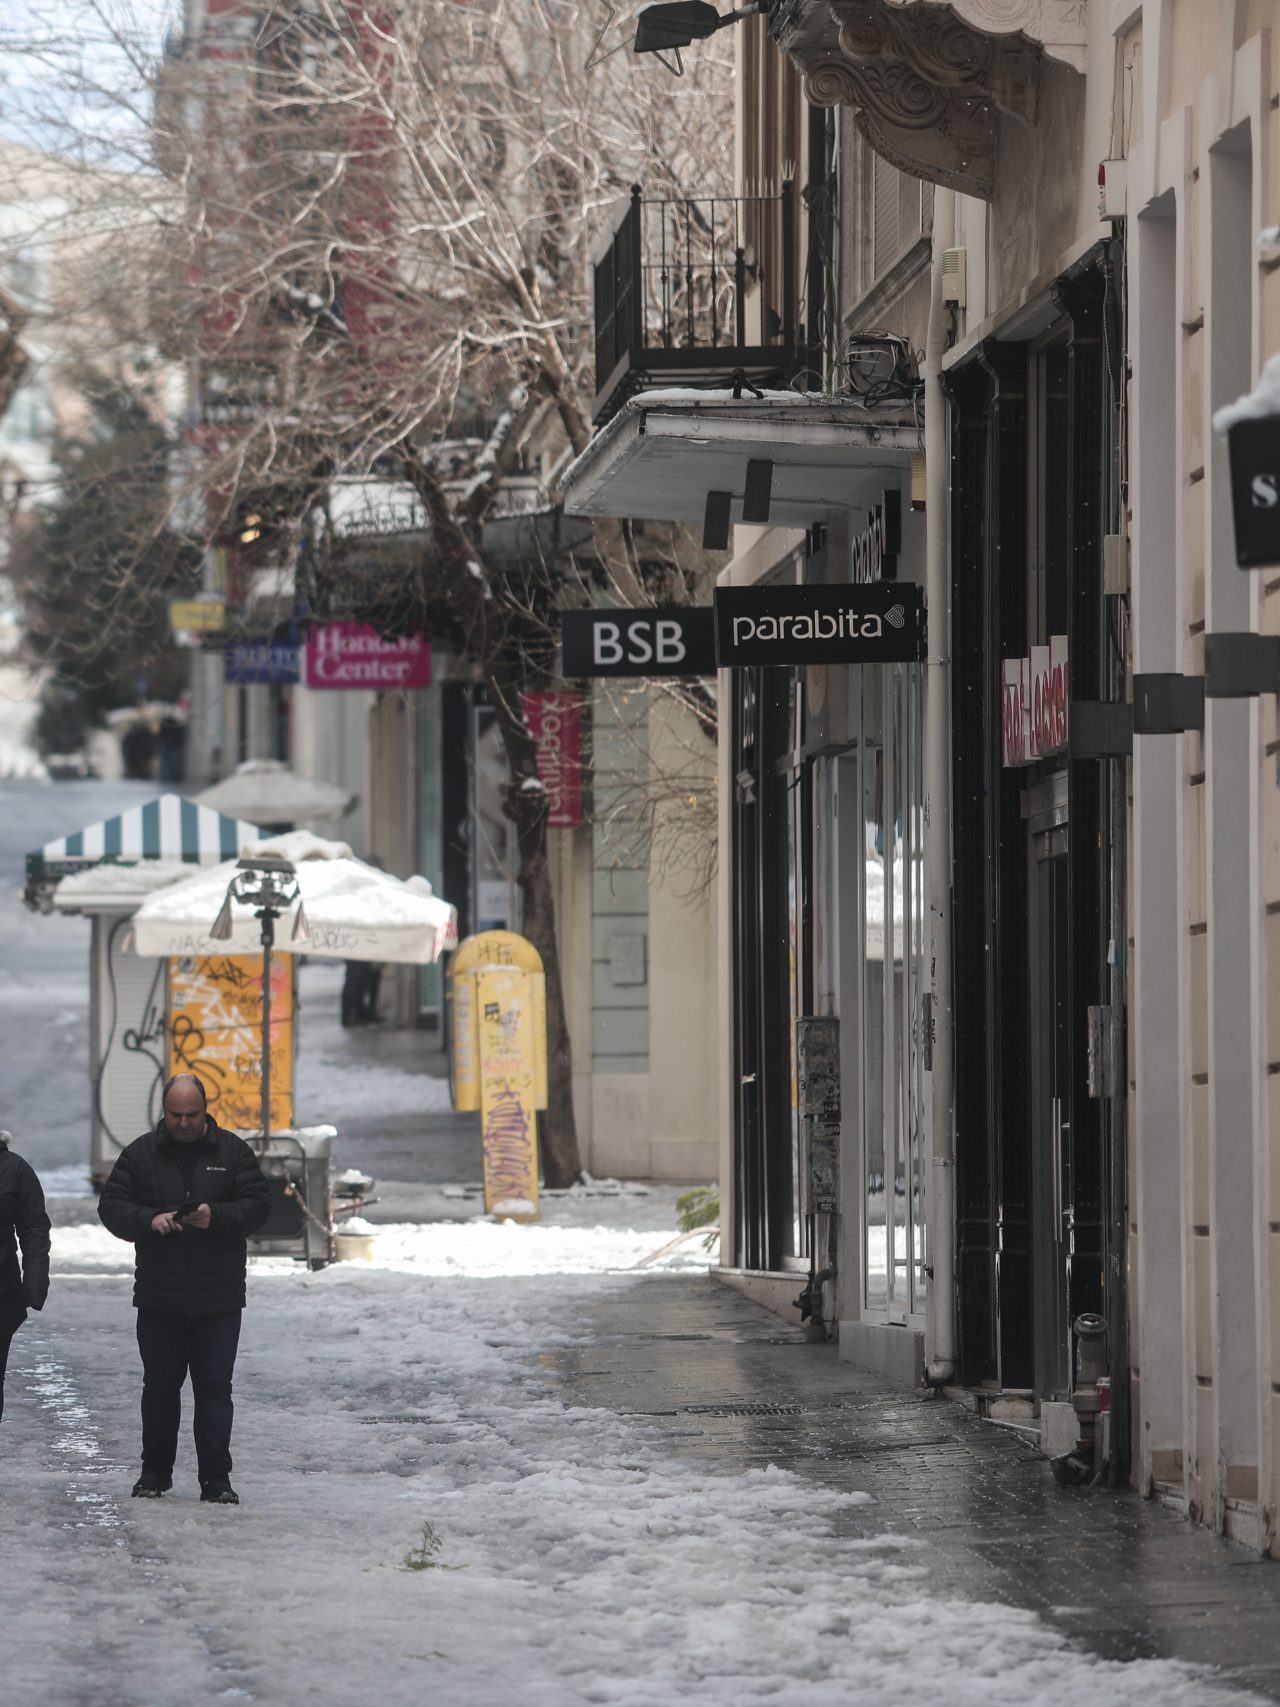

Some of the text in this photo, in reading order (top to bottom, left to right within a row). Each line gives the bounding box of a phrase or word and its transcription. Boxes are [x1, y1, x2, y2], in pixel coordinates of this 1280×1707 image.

[593, 620, 687, 665] BSB
[733, 608, 883, 646] parabita
[315, 656, 411, 681] Center
